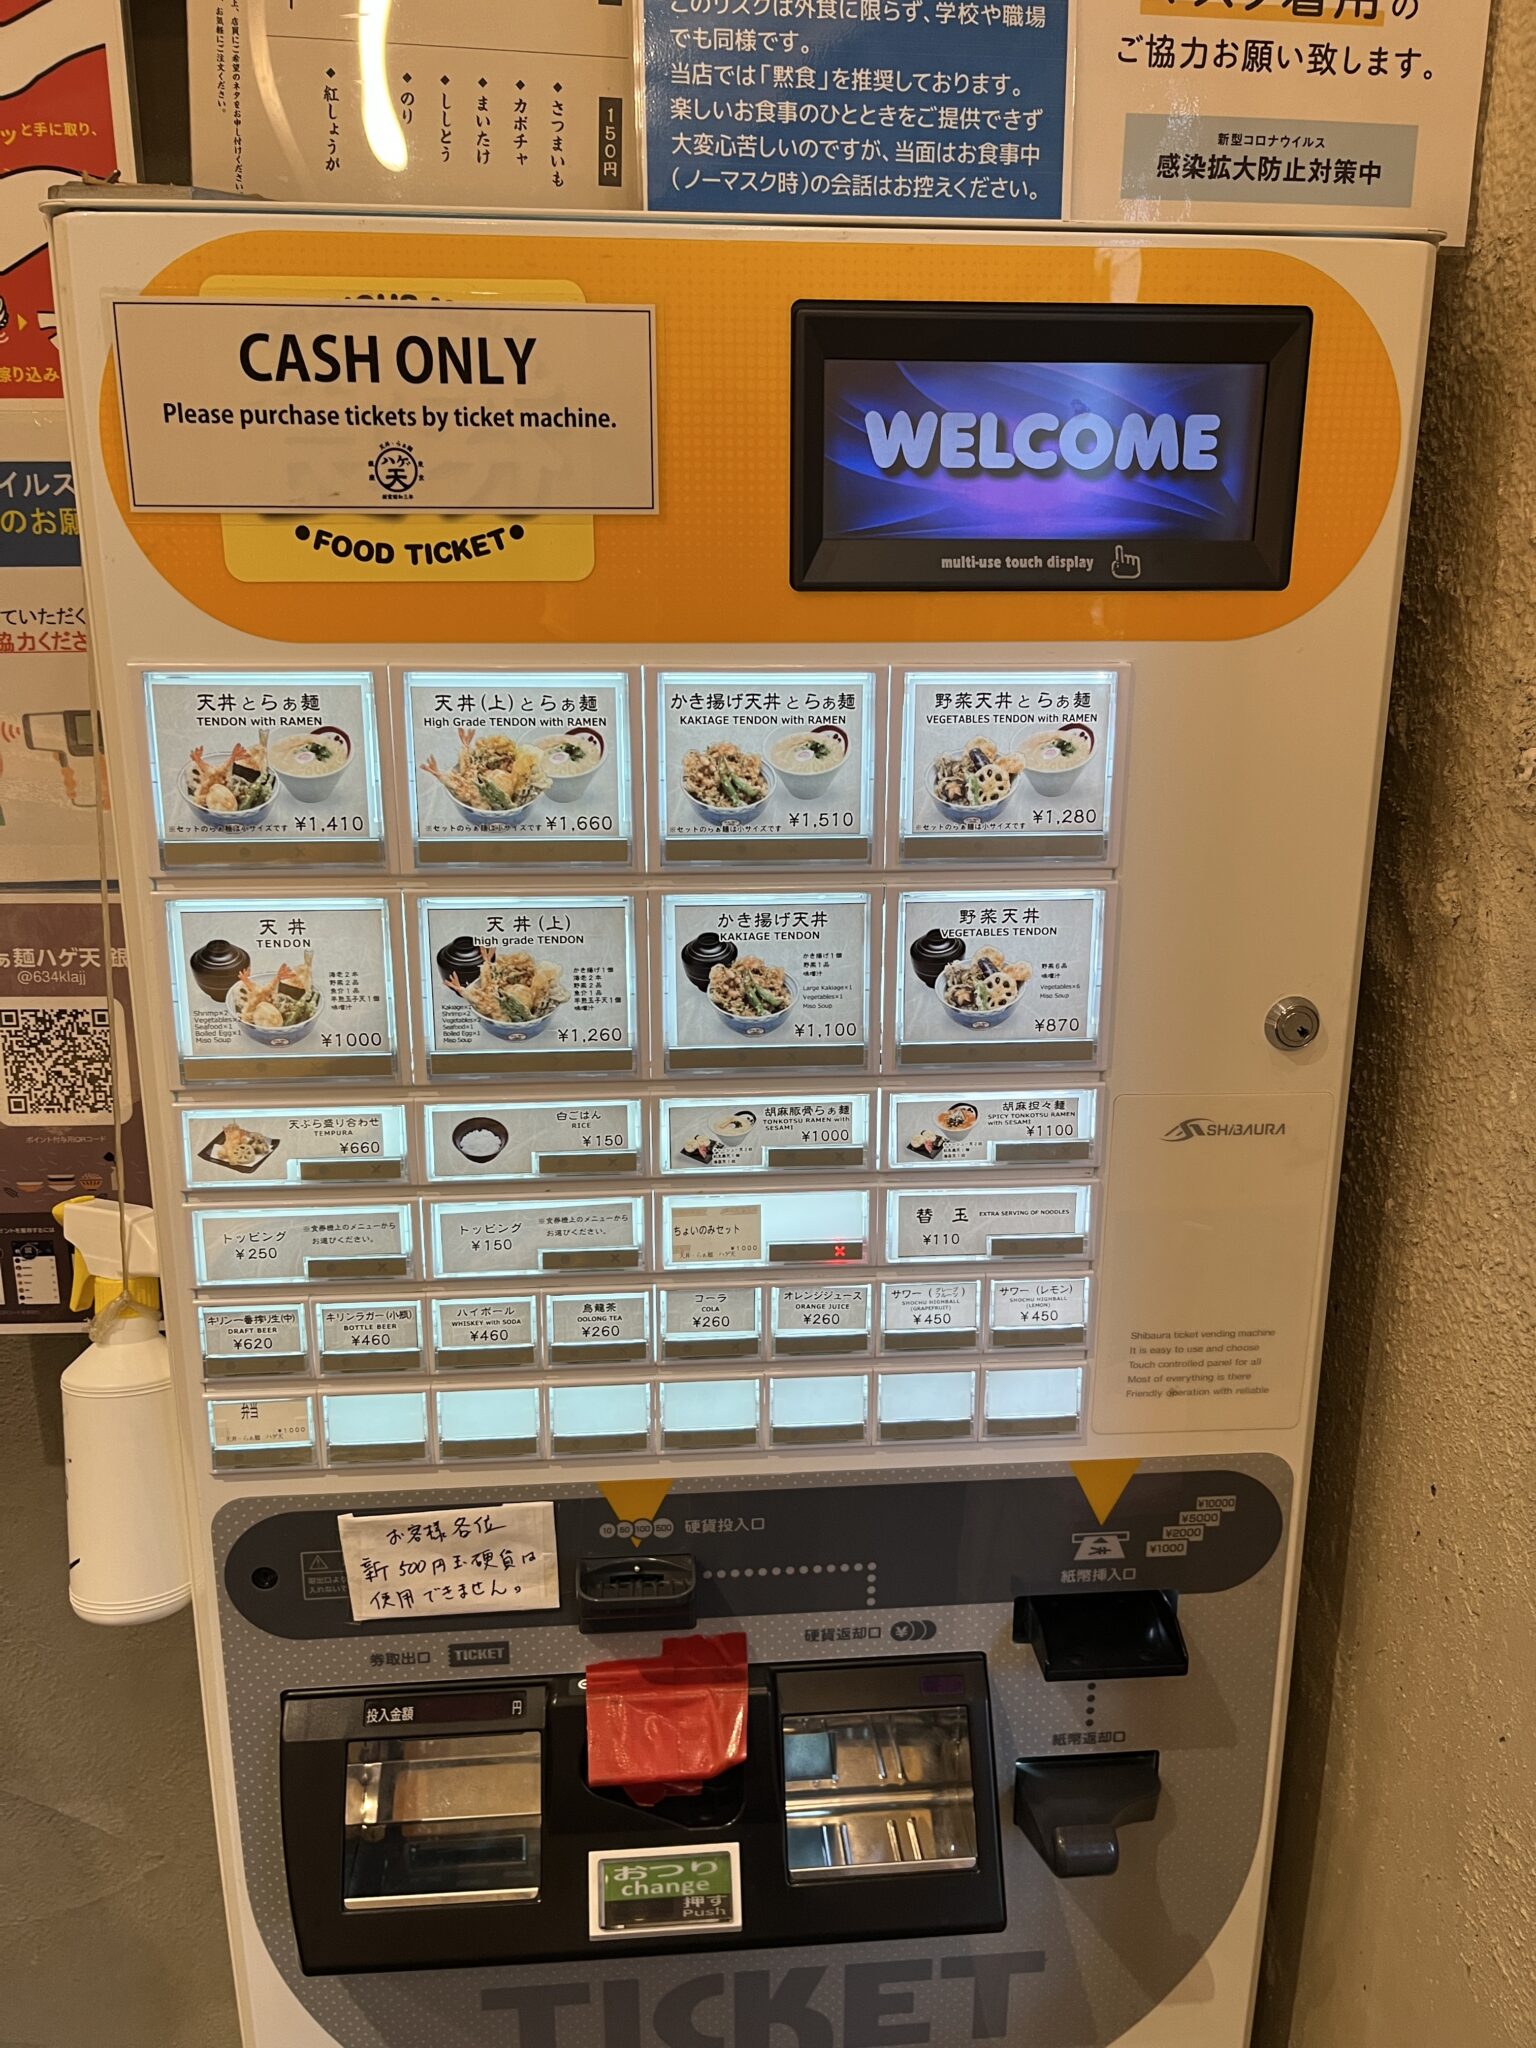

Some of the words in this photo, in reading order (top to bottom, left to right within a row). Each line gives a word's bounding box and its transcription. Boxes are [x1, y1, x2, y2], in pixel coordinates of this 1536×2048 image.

[670, 28, 811, 55] でも同様です。
[1117, 33, 1433, 81] ご協力お願い致します。
[670, 63, 1021, 96] 当店では「黙食」を推奨しております。
[401, 92, 414, 124] のり
[670, 98, 1044, 131] 楽しいお食事のひとときをご提供できず
[324, 86, 340, 171] 紅しょうが
[441, 92, 452, 162] ししとう
[476, 96, 490, 165] まいたけ
[514, 98, 528, 165] カボチャ
[551, 100, 565, 187] さつまいも
[603, 108, 617, 177] 150円
[1217, 133, 1325, 149] 新型コロナウイルス
[672, 133, 1040, 166] 大変心苦しいのですが、当面はお食事中
[1156, 153, 1381, 186] 感染拡大防止対策中
[239, 332, 380, 383] CASH
[396, 336, 537, 385] ONLY
[162, 403, 234, 426] Please
[240, 406, 340, 429] purchase
[345, 405, 417, 427] tickets
[421, 407, 448, 430] by
[454, 408, 515, 428] ticket
[519, 408, 617, 429] machine.
[864, 409, 1222, 471] WELCOME
[313, 528, 396, 565] FOOD
[405, 527, 506, 566] TICKET
[941, 555, 1002, 570] multi-use
[1005, 555, 1043, 569] touch
[1046, 555, 1095, 572] display
[1, 607, 86, 625] ていただく
[197, 693, 320, 712] 天丼とらぁ麺
[434, 694, 598, 713] 天丼(上)とらぁ麺
[671, 692, 856, 711] かき揚げ天丼とらぁ麺
[935, 691, 1091, 710] 野菜天丼とらぁ麺
[196, 717, 247, 726] TENDON
[251, 717, 276, 726] with
[280, 717, 322, 726] RAMEN
[424, 718, 449, 728] High
[453, 718, 486, 726] Grade
[489, 718, 536, 726] TENDON
[540, 718, 563, 726] with
[567, 718, 607, 726] RAMEN
[680, 716, 729, 725] KAKIAGE
[733, 716, 778, 725] TENDON
[782, 716, 804, 725] with
[808, 716, 846, 724] RAMEN
[926, 715, 990, 724] VEGETABLES
[993, 714, 1034, 723] TENDON
[1038, 714, 1059, 722] with
[1062, 714, 1097, 722] RAMEN
[546, 816, 612, 831] ¥1,660
[789, 812, 854, 827] ¥1,510
[1033, 809, 1097, 824] ¥1,280
[294, 816, 363, 832] ¥1,410
[718, 911, 828, 928] かき揚げ天丼
[959, 908, 1040, 924] 野菜天丼
[259, 918, 306, 935] 天丼
[942, 928, 1010, 938] VEGETABLES
[1013, 927, 1057, 936] TENDON
[474, 936, 498, 946] high
[502, 936, 534, 946] grade
[538, 936, 584, 944] TENDON
[720, 932, 770, 941] KAKIAGE
[774, 931, 820, 940] TENDON
[256, 939, 311, 948] TENDON
[794, 1023, 856, 1037] ¥1,100
[1035, 1018, 1079, 1032] ¥870
[321, 1033, 382, 1047] ¥1000
[558, 1028, 622, 1043] ¥1,260
[764, 1105, 850, 1117] 胡麻豚骨らぁ麺
[1002, 1100, 1065, 1111] 胡麻担々麺
[556, 1110, 601, 1121] 白ごはん
[289, 1118, 379, 1129] 天ぷら盛り合わせ
[1207, 1123, 1285, 1137] SHIBAURA
[802, 1130, 849, 1142] ¥1000
[1026, 1125, 1073, 1137] ¥1100
[339, 1142, 380, 1154] ¥660
[582, 1135, 623, 1147] ¥150
[916, 1208, 969, 1224] 替玉
[460, 1223, 522, 1235] トッピング
[674, 1225, 740, 1236] ちょいのみセット
[224, 1231, 287, 1244] トッピング
[923, 1234, 960, 1245] ¥110
[471, 1239, 512, 1251] ¥150
[235, 1248, 277, 1260] ¥250
[695, 1293, 727, 1303] コーラ
[784, 1291, 862, 1300] オレンジジュース
[457, 1307, 515, 1317] ハイボール
[803, 1313, 840, 1325] ¥260
[913, 1313, 951, 1324] ¥450
[1021, 1310, 1058, 1321] ¥450
[692, 1316, 729, 1327] ¥260
[470, 1330, 508, 1342] ¥460
[581, 1326, 620, 1337] ¥260
[1131, 1332, 1171, 1340] Shibaura
[1174, 1331, 1198, 1339] ticket
[1201, 1330, 1235, 1339] vending
[1238, 1329, 1275, 1337] machine
[233, 1338, 273, 1350] ¥620
[351, 1334, 390, 1346] ¥460
[1182, 1514, 1218, 1522] ¥5000
[685, 1518, 765, 1533] 硬貨投入口
[1166, 1528, 1201, 1538] ¥2000
[1150, 1543, 1184, 1553] ¥1000
[1061, 1568, 1136, 1583] 紙幣挿入口
[804, 1626, 882, 1642] 硬貨返却口
[370, 1652, 430, 1667] 券取出口
[454, 1648, 504, 1661] TICKET
[367, 1706, 414, 1724] 投入金額
[512, 1700, 522, 1715] 円
[1051, 1731, 1125, 1746] 紙幣返却口
[614, 1861, 718, 1880] おつり
[622, 1880, 710, 1896] change
[683, 1895, 727, 1908] 押す
[683, 1908, 726, 1917] Push
